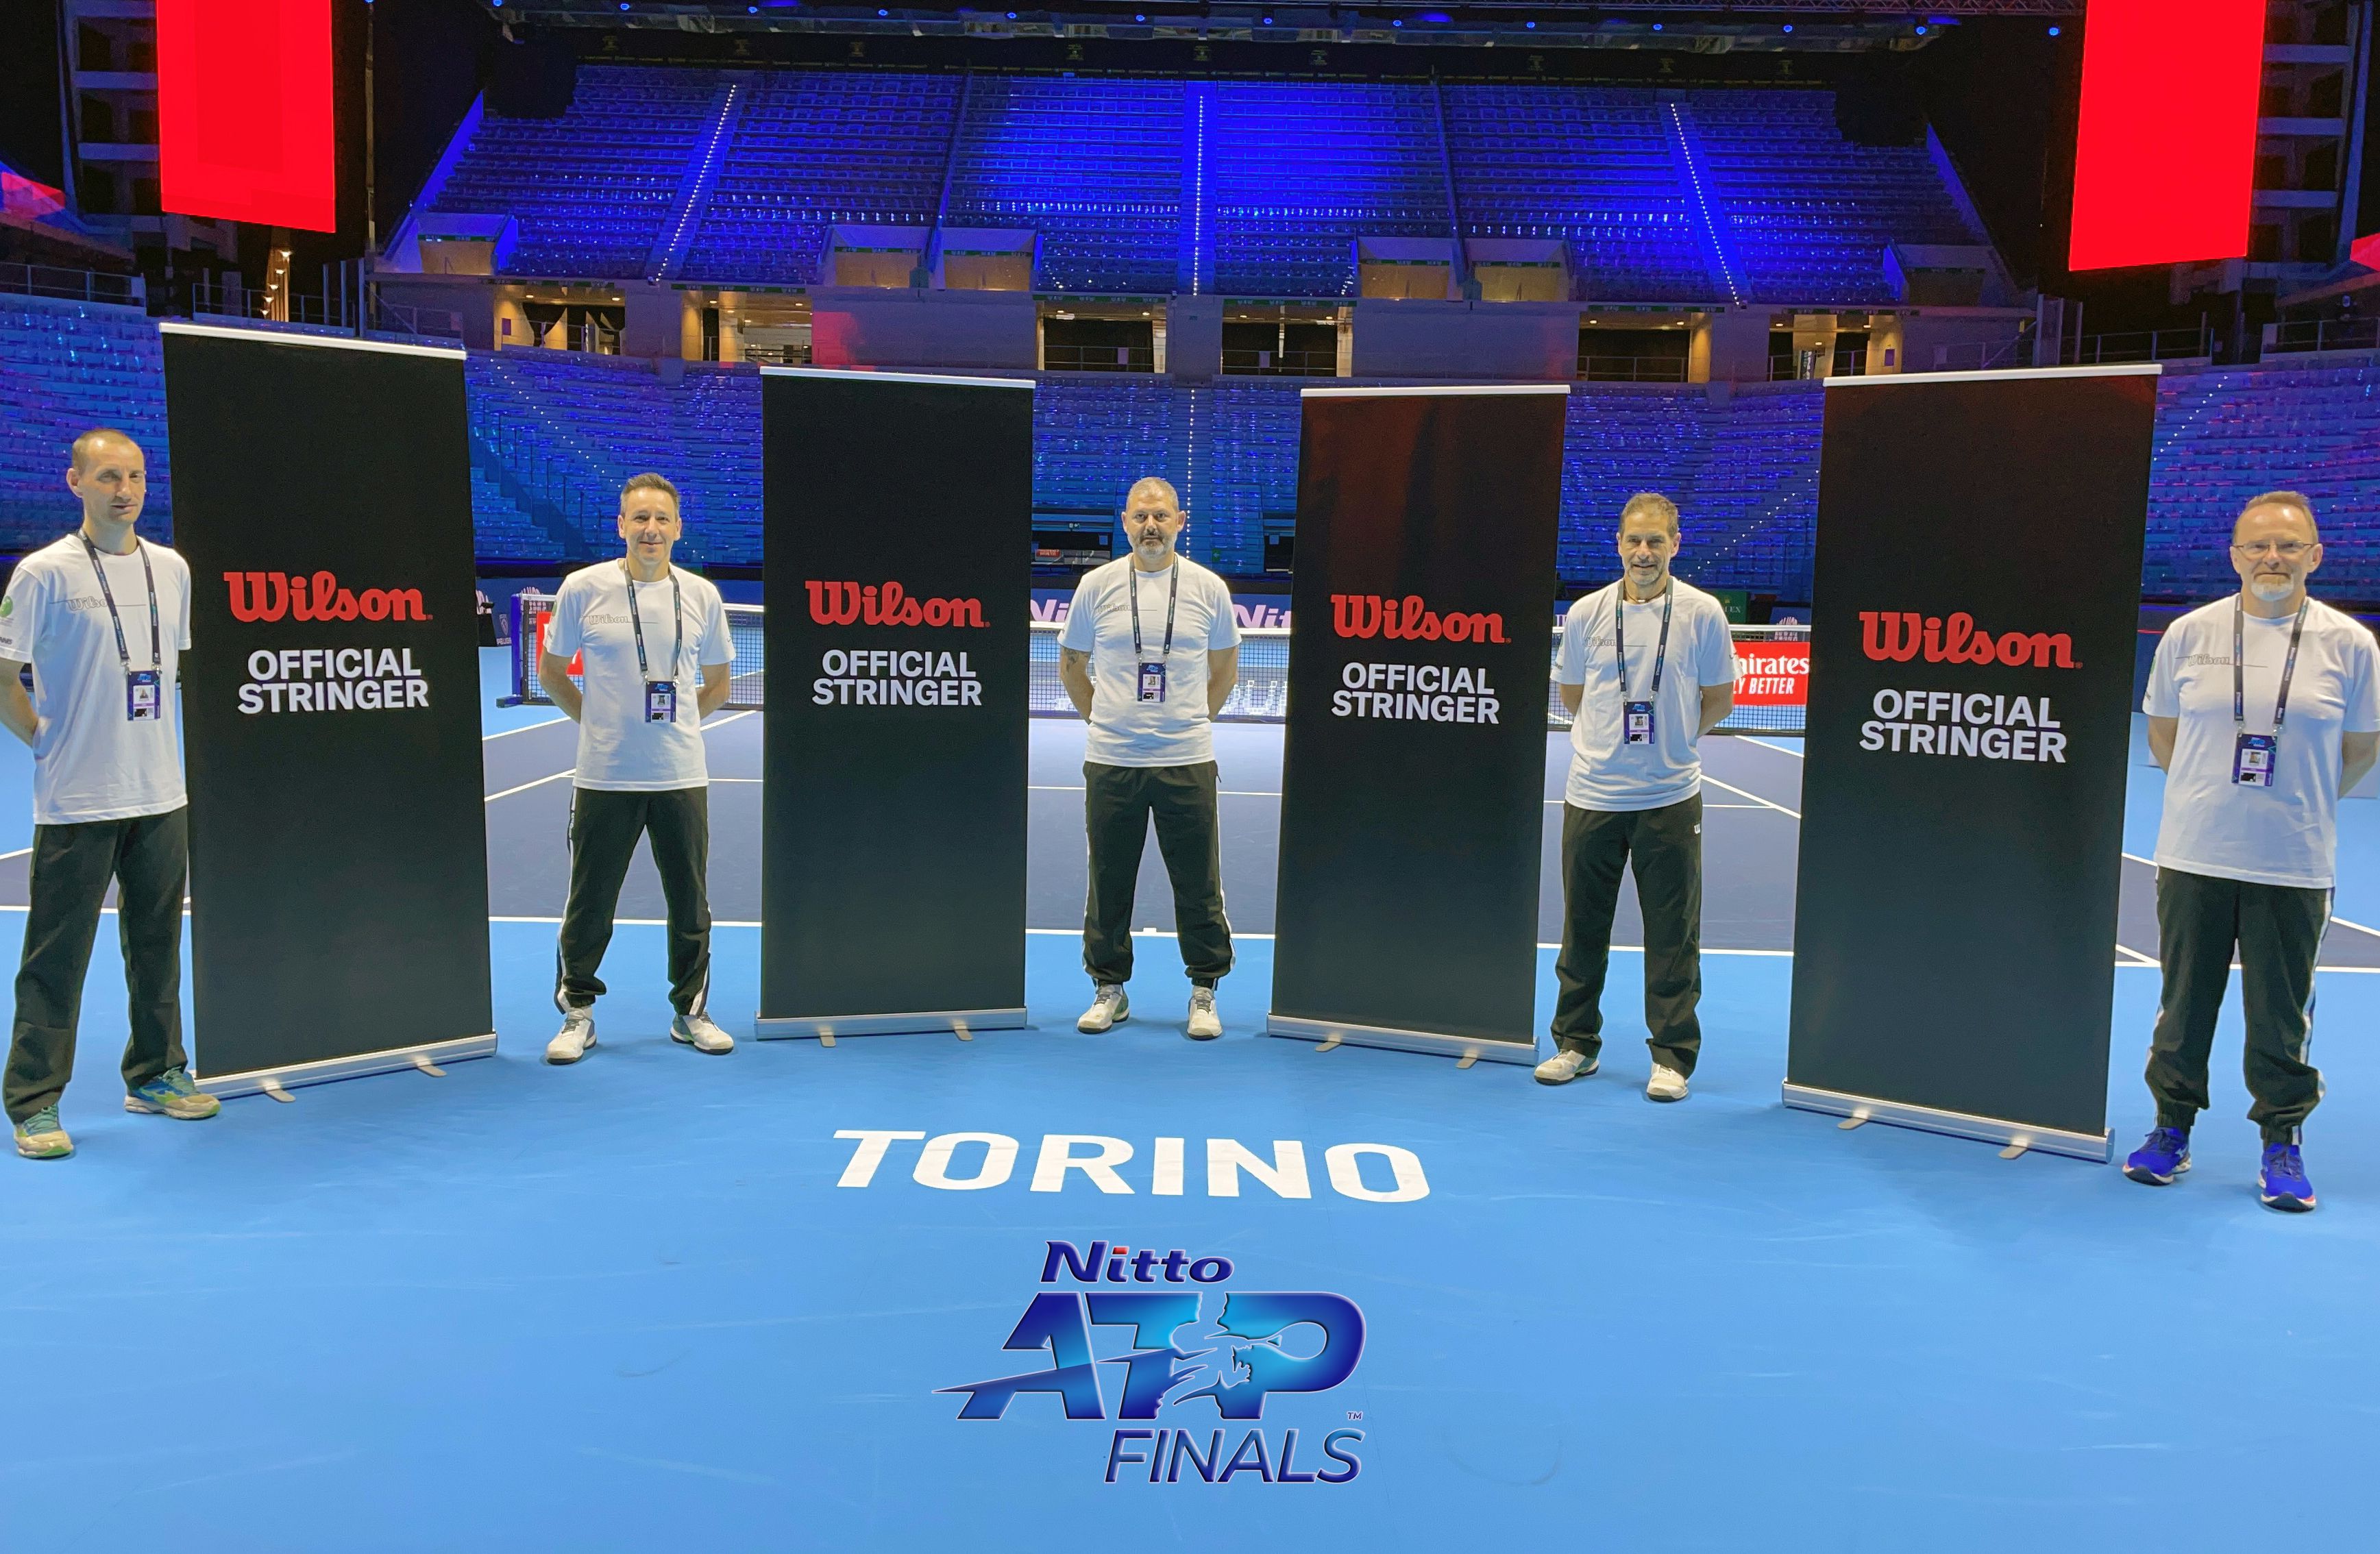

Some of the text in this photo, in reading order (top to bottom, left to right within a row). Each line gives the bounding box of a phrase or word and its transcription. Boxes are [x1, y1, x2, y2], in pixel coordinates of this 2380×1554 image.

[68, 595, 107, 611] Wilso
[224, 570, 428, 622] Wilson
[805, 580, 985, 628] Wilson
[1330, 594, 1506, 643] Wilson
[1858, 611, 2075, 669] Wilson
[247, 648, 422, 681] OFFICIAL
[822, 649, 977, 678] OFFICIAL
[1342, 662, 1495, 695] OFFICIAL
[1739, 653, 1810, 675] irates
[237, 679, 430, 715] STRINGER
[812, 678, 982, 706] STRINGER
[1732, 677, 1795, 695] LY BETTER
[1331, 690, 1500, 724] STRINGER
[1873, 689, 2061, 728] OFFICIAL
[1859, 720, 2067, 763] STRINGER
[833, 1130, 1430, 1202] TORINO
